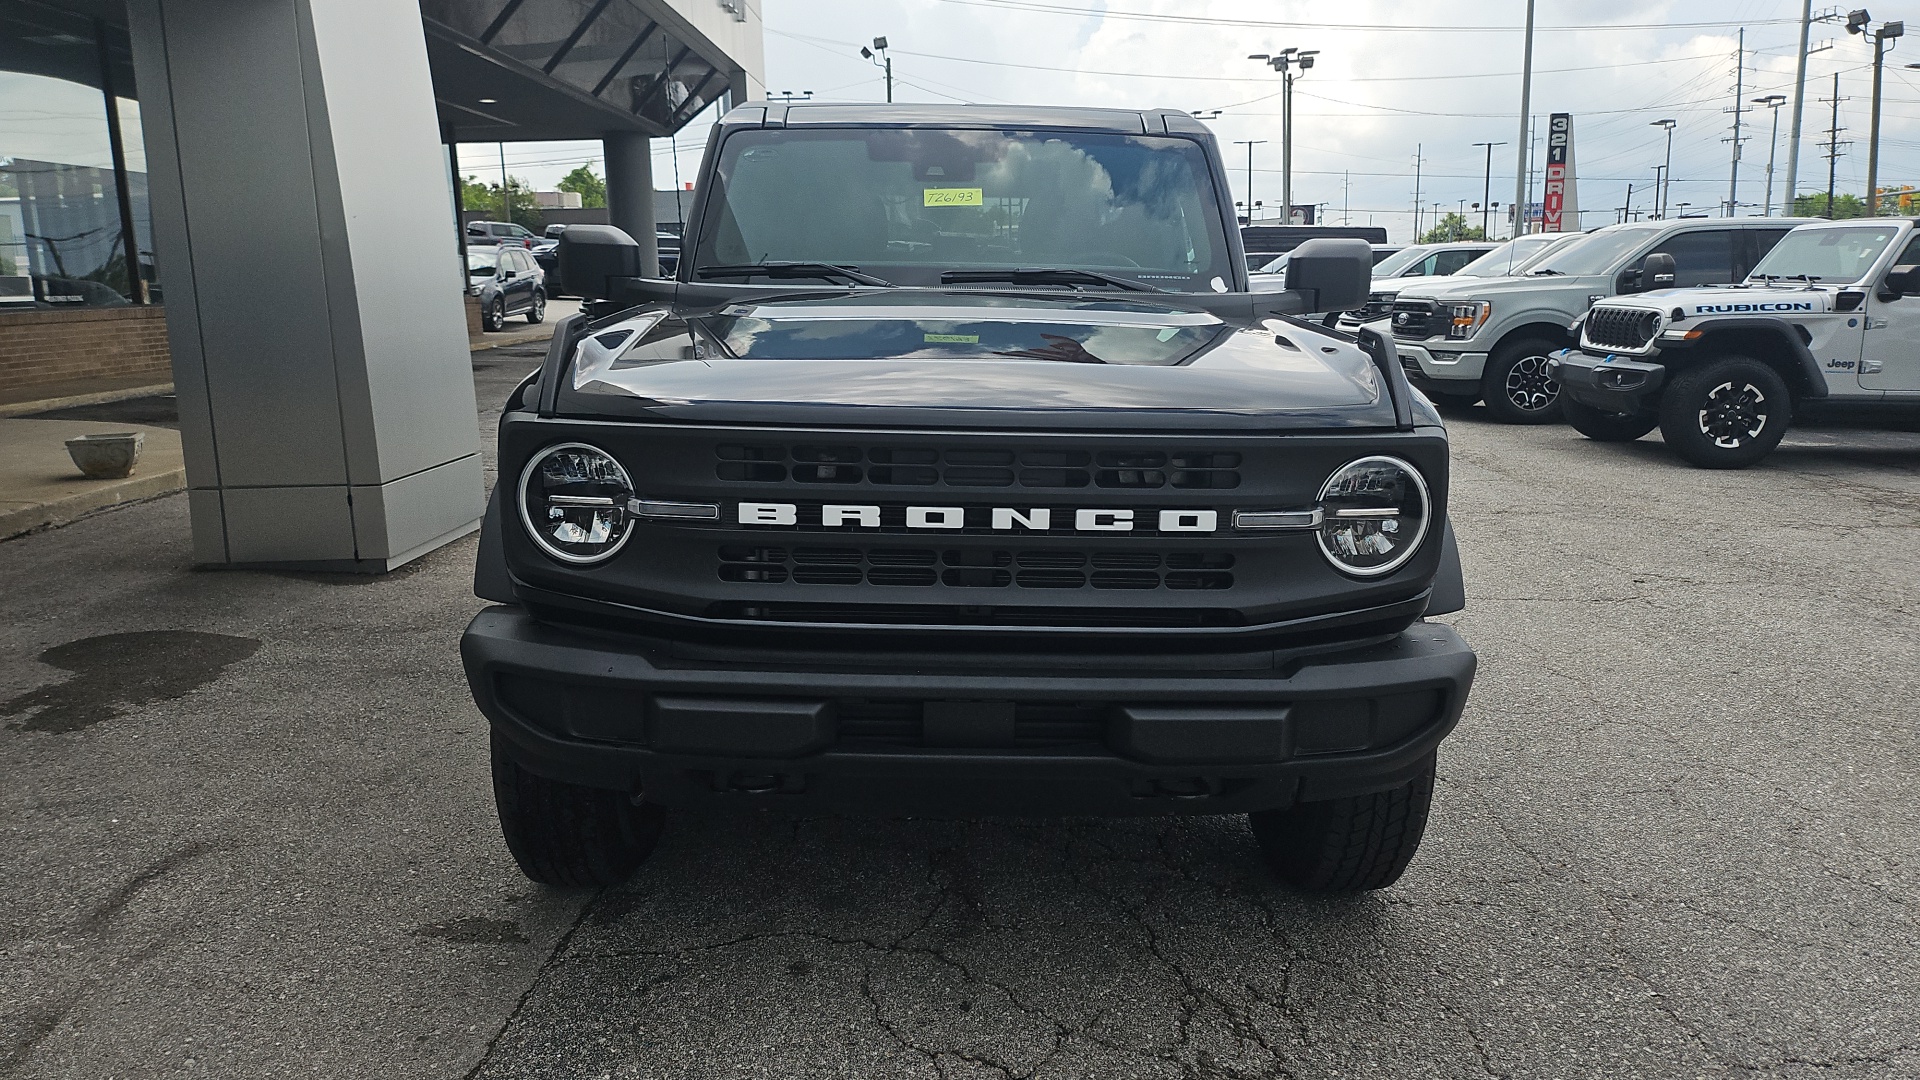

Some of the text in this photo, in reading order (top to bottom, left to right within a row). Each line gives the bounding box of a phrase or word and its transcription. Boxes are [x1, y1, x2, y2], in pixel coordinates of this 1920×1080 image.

[1551, 118, 1568, 161] 321
[928, 192, 973, 203] T26193
[1696, 302, 1811, 313] RUBICON
[1827, 359, 1855, 369] Jeep
[738, 502, 1218, 532] BRONCO
